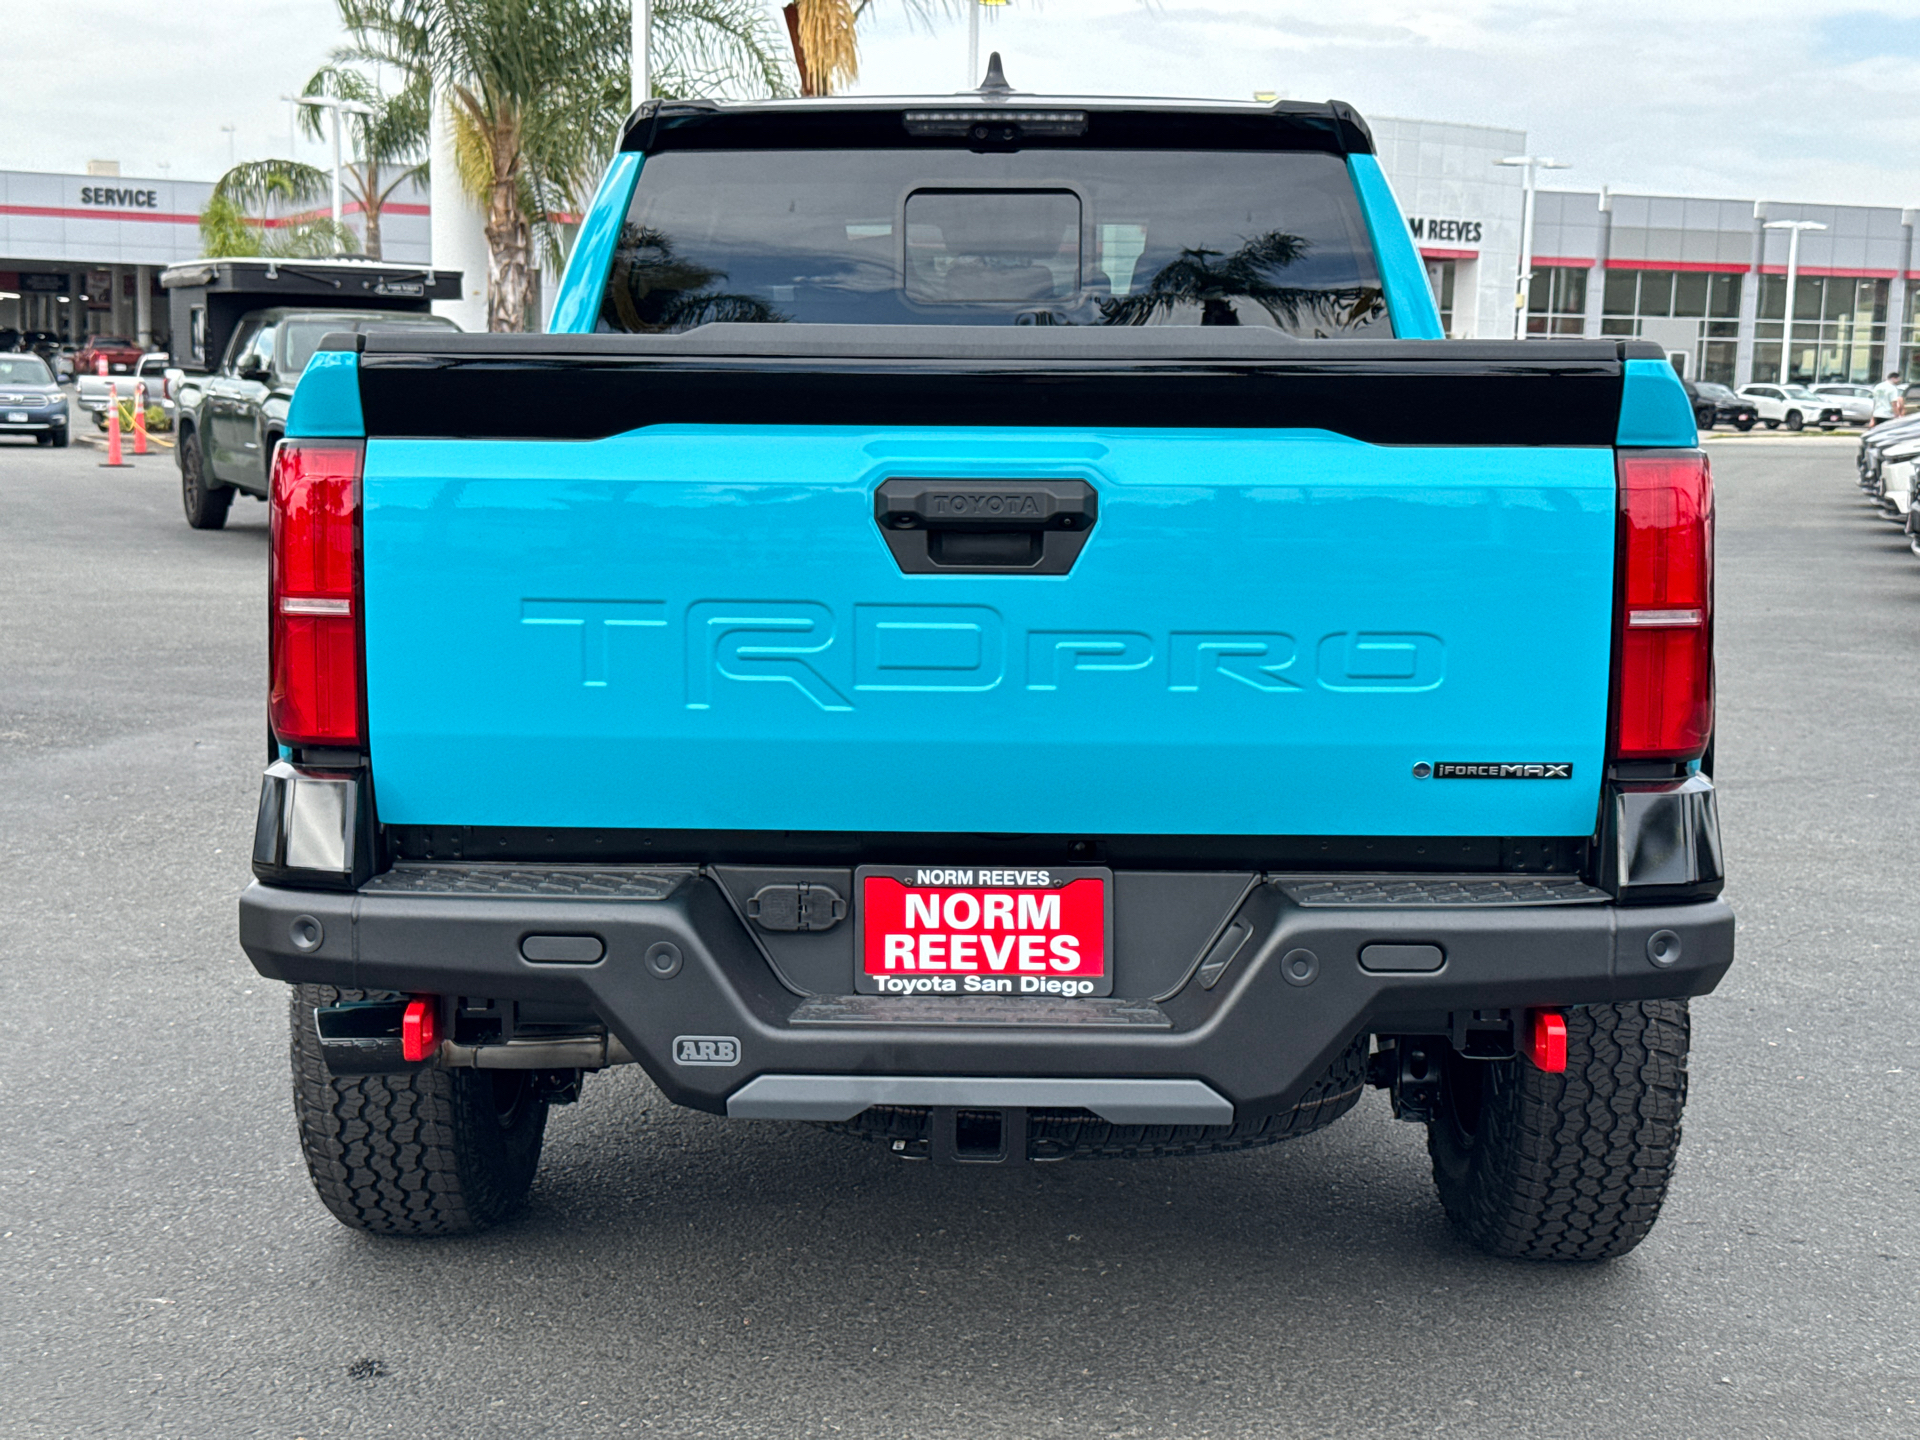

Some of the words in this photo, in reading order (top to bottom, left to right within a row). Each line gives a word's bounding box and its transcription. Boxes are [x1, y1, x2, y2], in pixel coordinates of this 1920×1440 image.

[81, 187, 157, 208] SERVICE
[1428, 220, 1482, 242] REEVES
[933, 495, 1039, 515] TOYOTA
[520, 598, 1005, 712] TRD
[1026, 630, 1446, 693] PRO
[916, 869, 973, 885] NORM
[978, 870, 1050, 886] REEVES
[905, 892, 1061, 930] NORM
[884, 934, 1081, 972] REEVES
[873, 975, 957, 995] Toyota
[963, 975, 1012, 993] San
[1020, 976, 1094, 997] Diego
[680, 1041, 735, 1061] ARB
